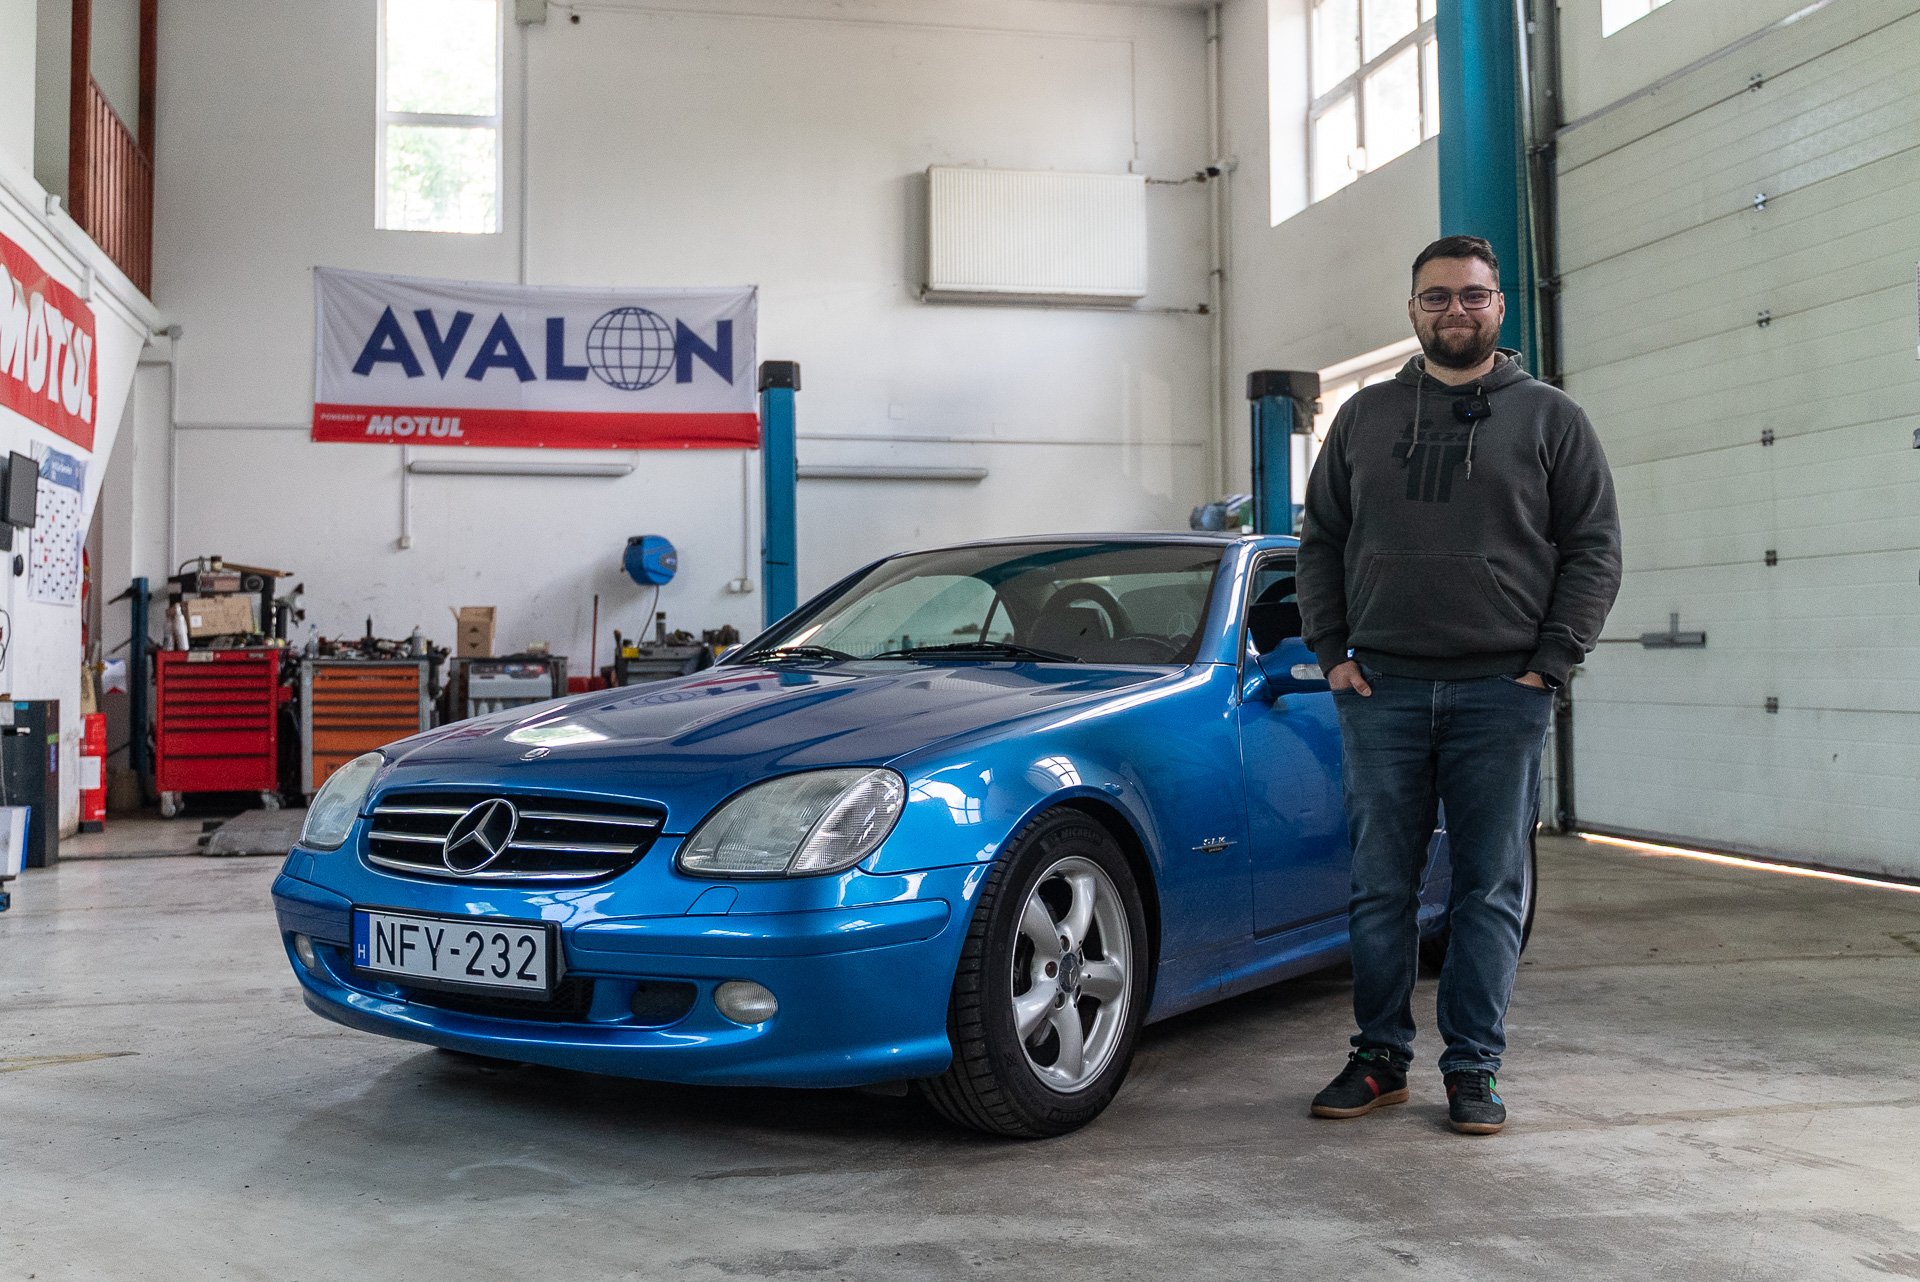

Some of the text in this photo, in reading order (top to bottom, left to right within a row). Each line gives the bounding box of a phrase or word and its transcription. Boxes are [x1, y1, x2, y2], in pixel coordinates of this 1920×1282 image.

[0, 264, 92, 424] MOTUL
[366, 415, 464, 437] MOTUL
[357, 943, 366, 960] H
[376, 920, 537, 981] NFY-232
